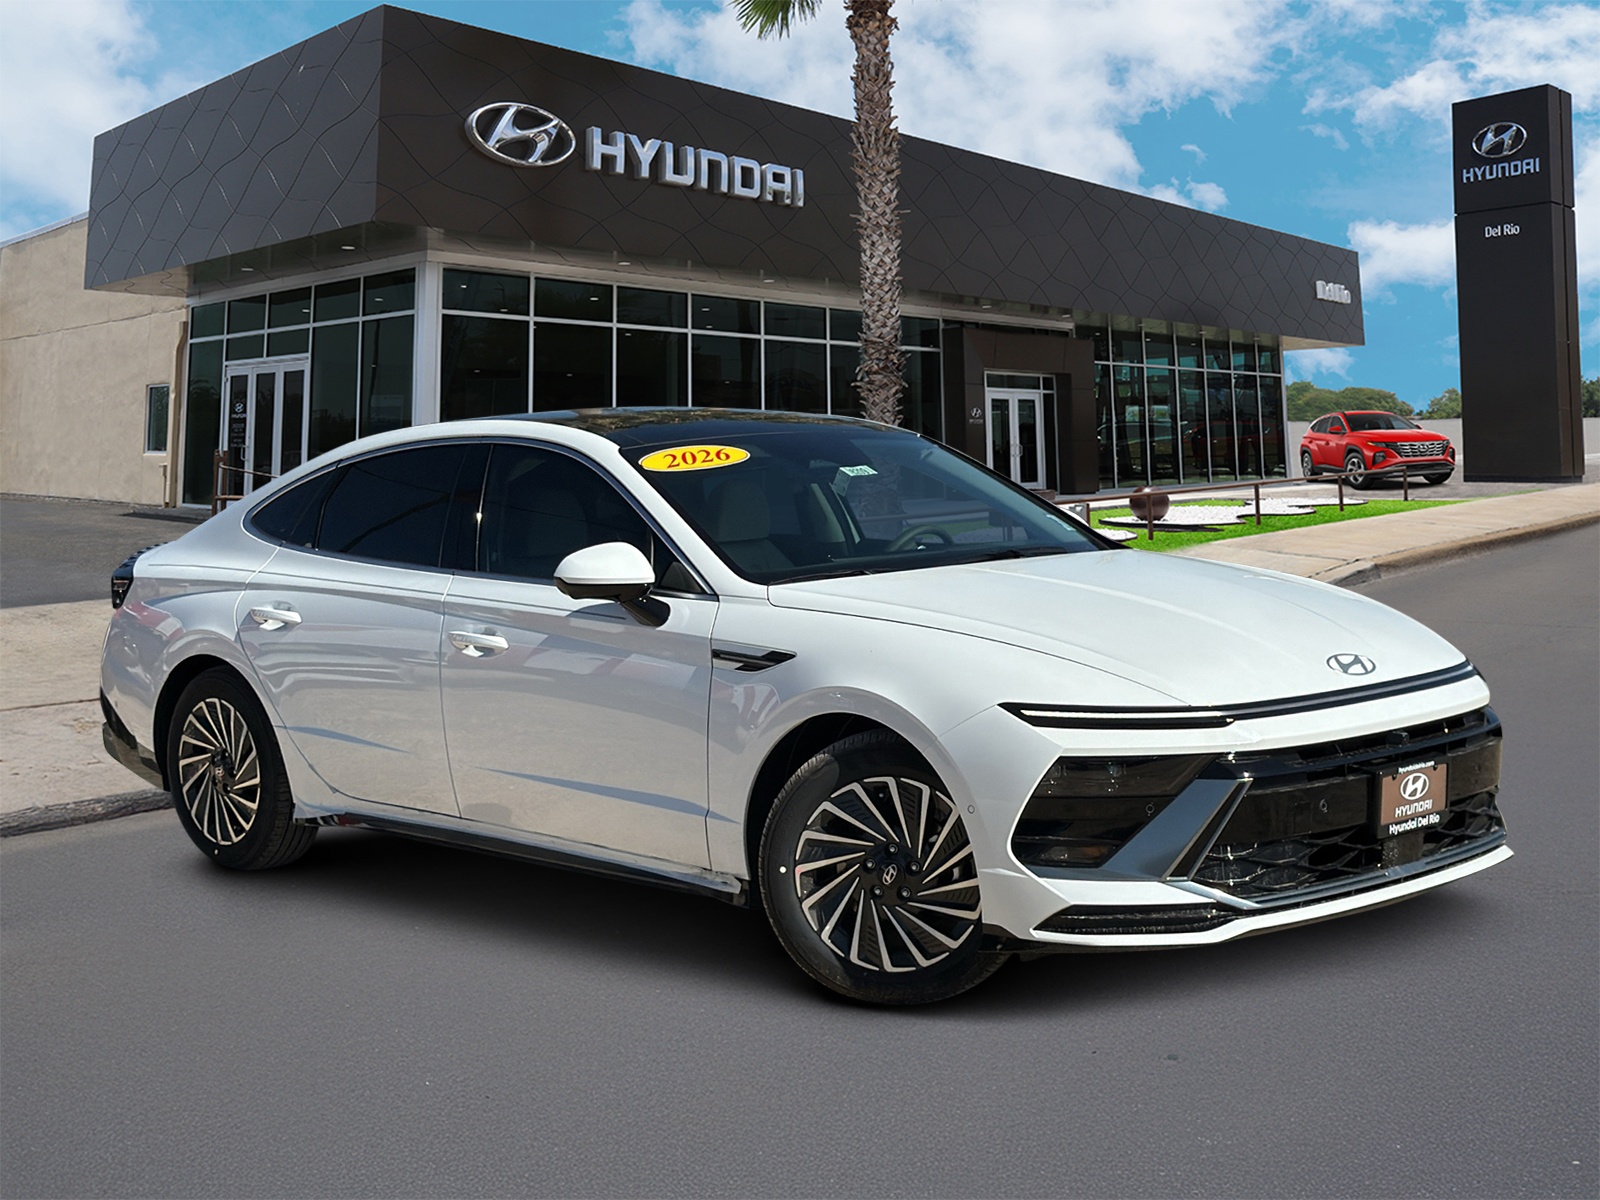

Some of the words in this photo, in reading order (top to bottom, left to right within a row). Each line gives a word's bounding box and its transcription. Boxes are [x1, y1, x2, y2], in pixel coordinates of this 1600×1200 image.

[586, 126, 804, 207] HYUNDAI
[1462, 157, 1540, 183] HYUNDAI
[1485, 225, 1501, 238] Del
[1503, 223, 1520, 236] Rio
[663, 448, 730, 468] 2026
[1395, 799, 1433, 818] HYUNDAI
[1389, 818, 1417, 835] Hyundai
[1417, 815, 1428, 827] Del
[1429, 813, 1440, 825] Rio
